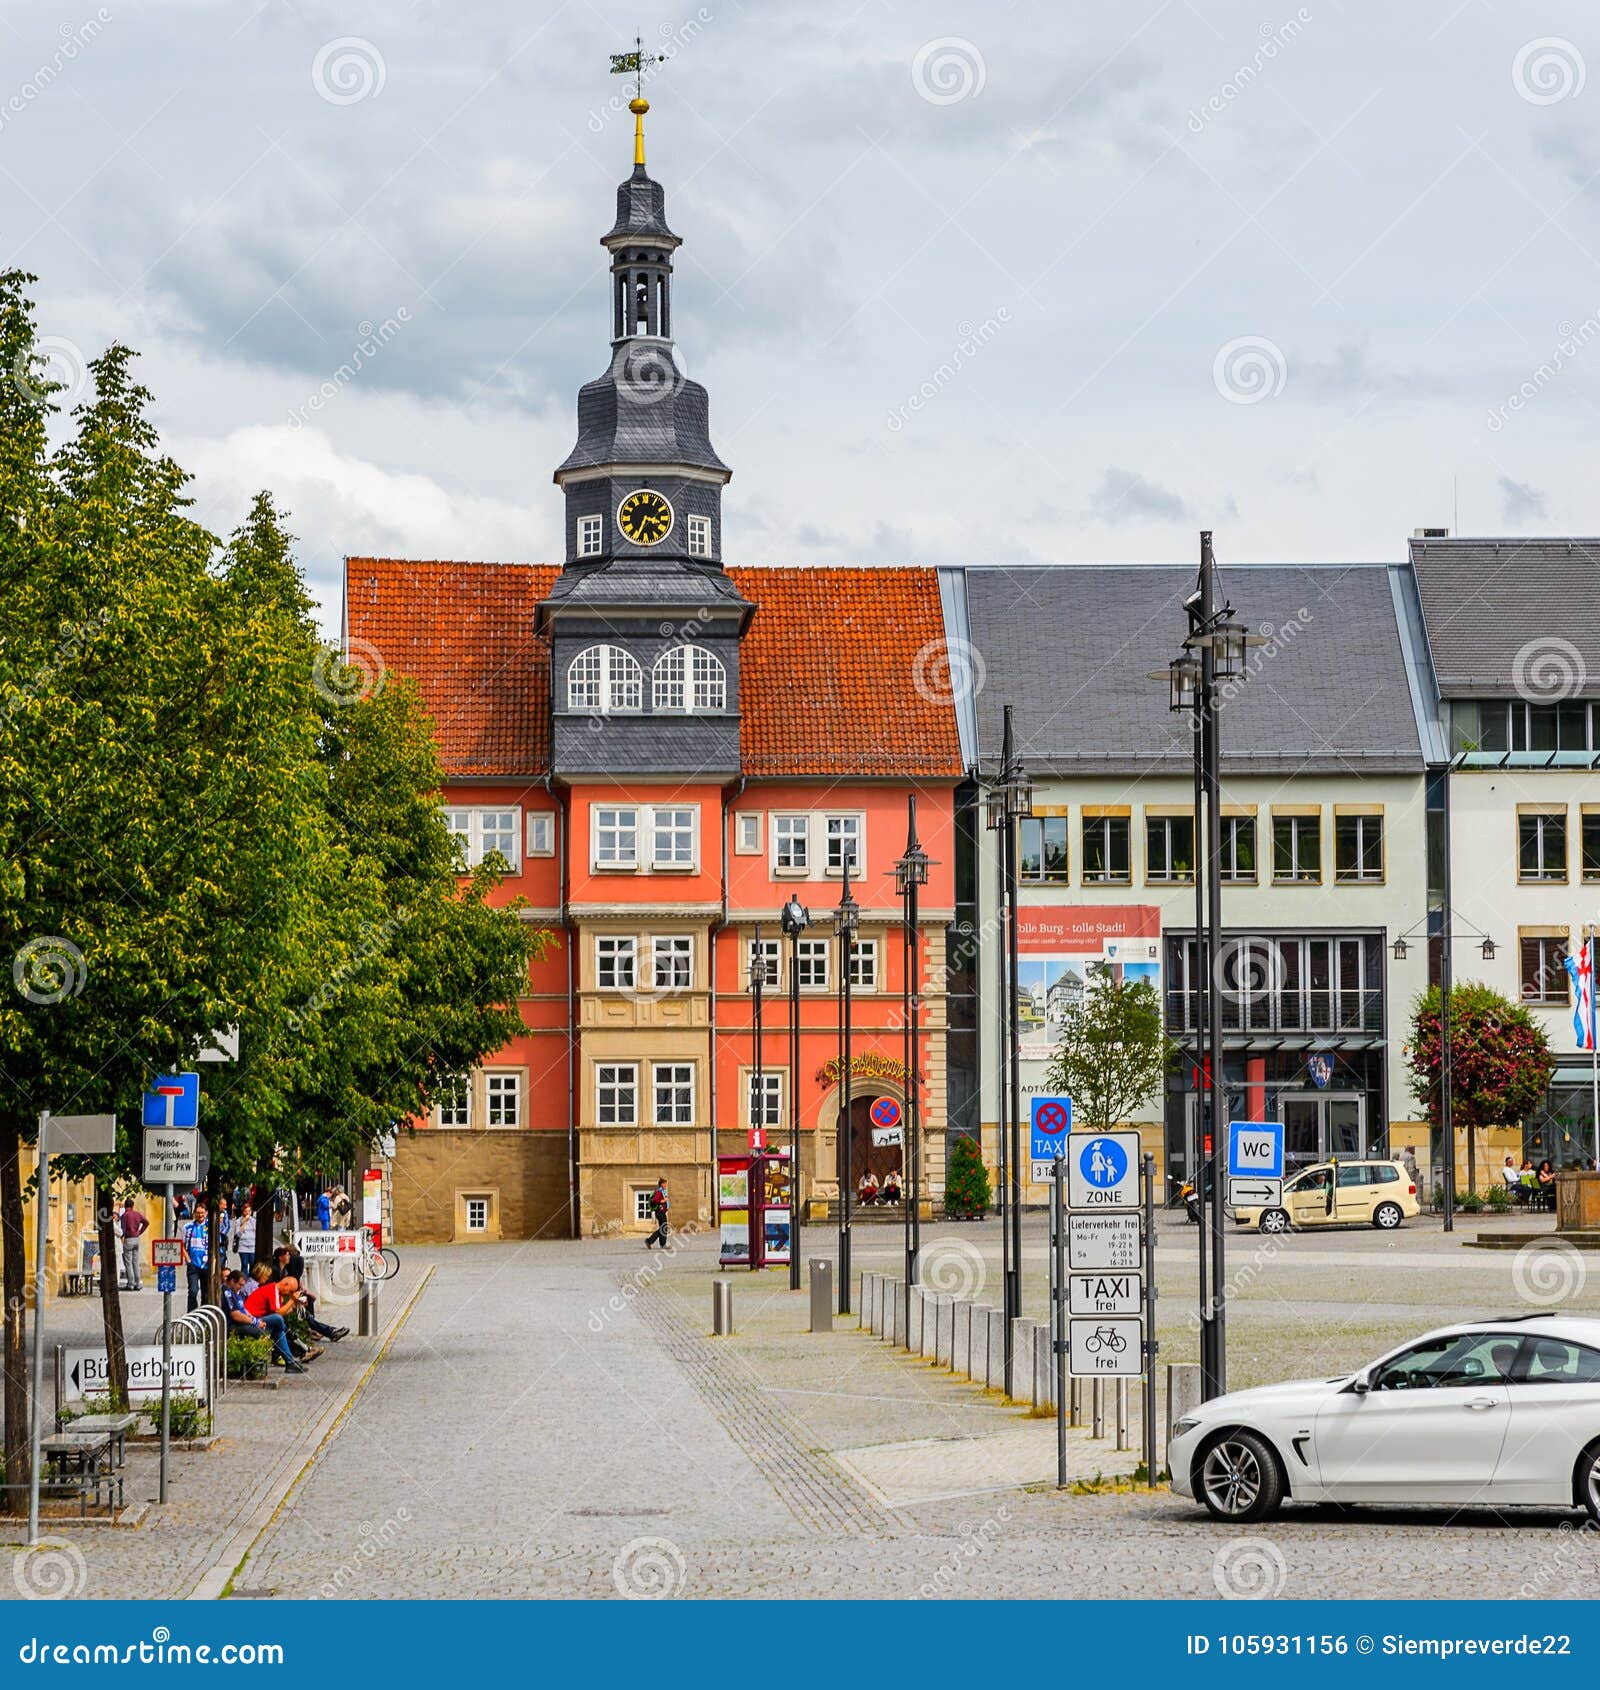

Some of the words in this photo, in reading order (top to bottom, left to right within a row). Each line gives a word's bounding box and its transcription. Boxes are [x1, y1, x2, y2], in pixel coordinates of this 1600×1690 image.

[1040, 923, 1063, 934] Burg
[1072, 922, 1094, 933] tolle
[1096, 922, 1126, 933] Stadt!
[156, 1138, 183, 1148] Wende-
[1243, 1142, 1271, 1158] WC
[149, 1151, 190, 1162] möglichkeit
[150, 1164, 161, 1172] nur
[163, 1162, 174, 1171] für
[176, 1162, 191, 1171] PKW
[1036, 1167, 1042, 1177] 3
[1086, 1191, 1122, 1203] ZONE
[1071, 1220, 1120, 1230] Lieferverkehr
[1125, 1220, 1138, 1229] frei
[306, 1244, 335, 1253] MUSEUM
[1080, 1278, 1130, 1299] TAXI
[1096, 1300, 1116, 1311] frei
[1095, 1356, 1118, 1368] frei
[84, 1357, 195, 1379] Büerbro
